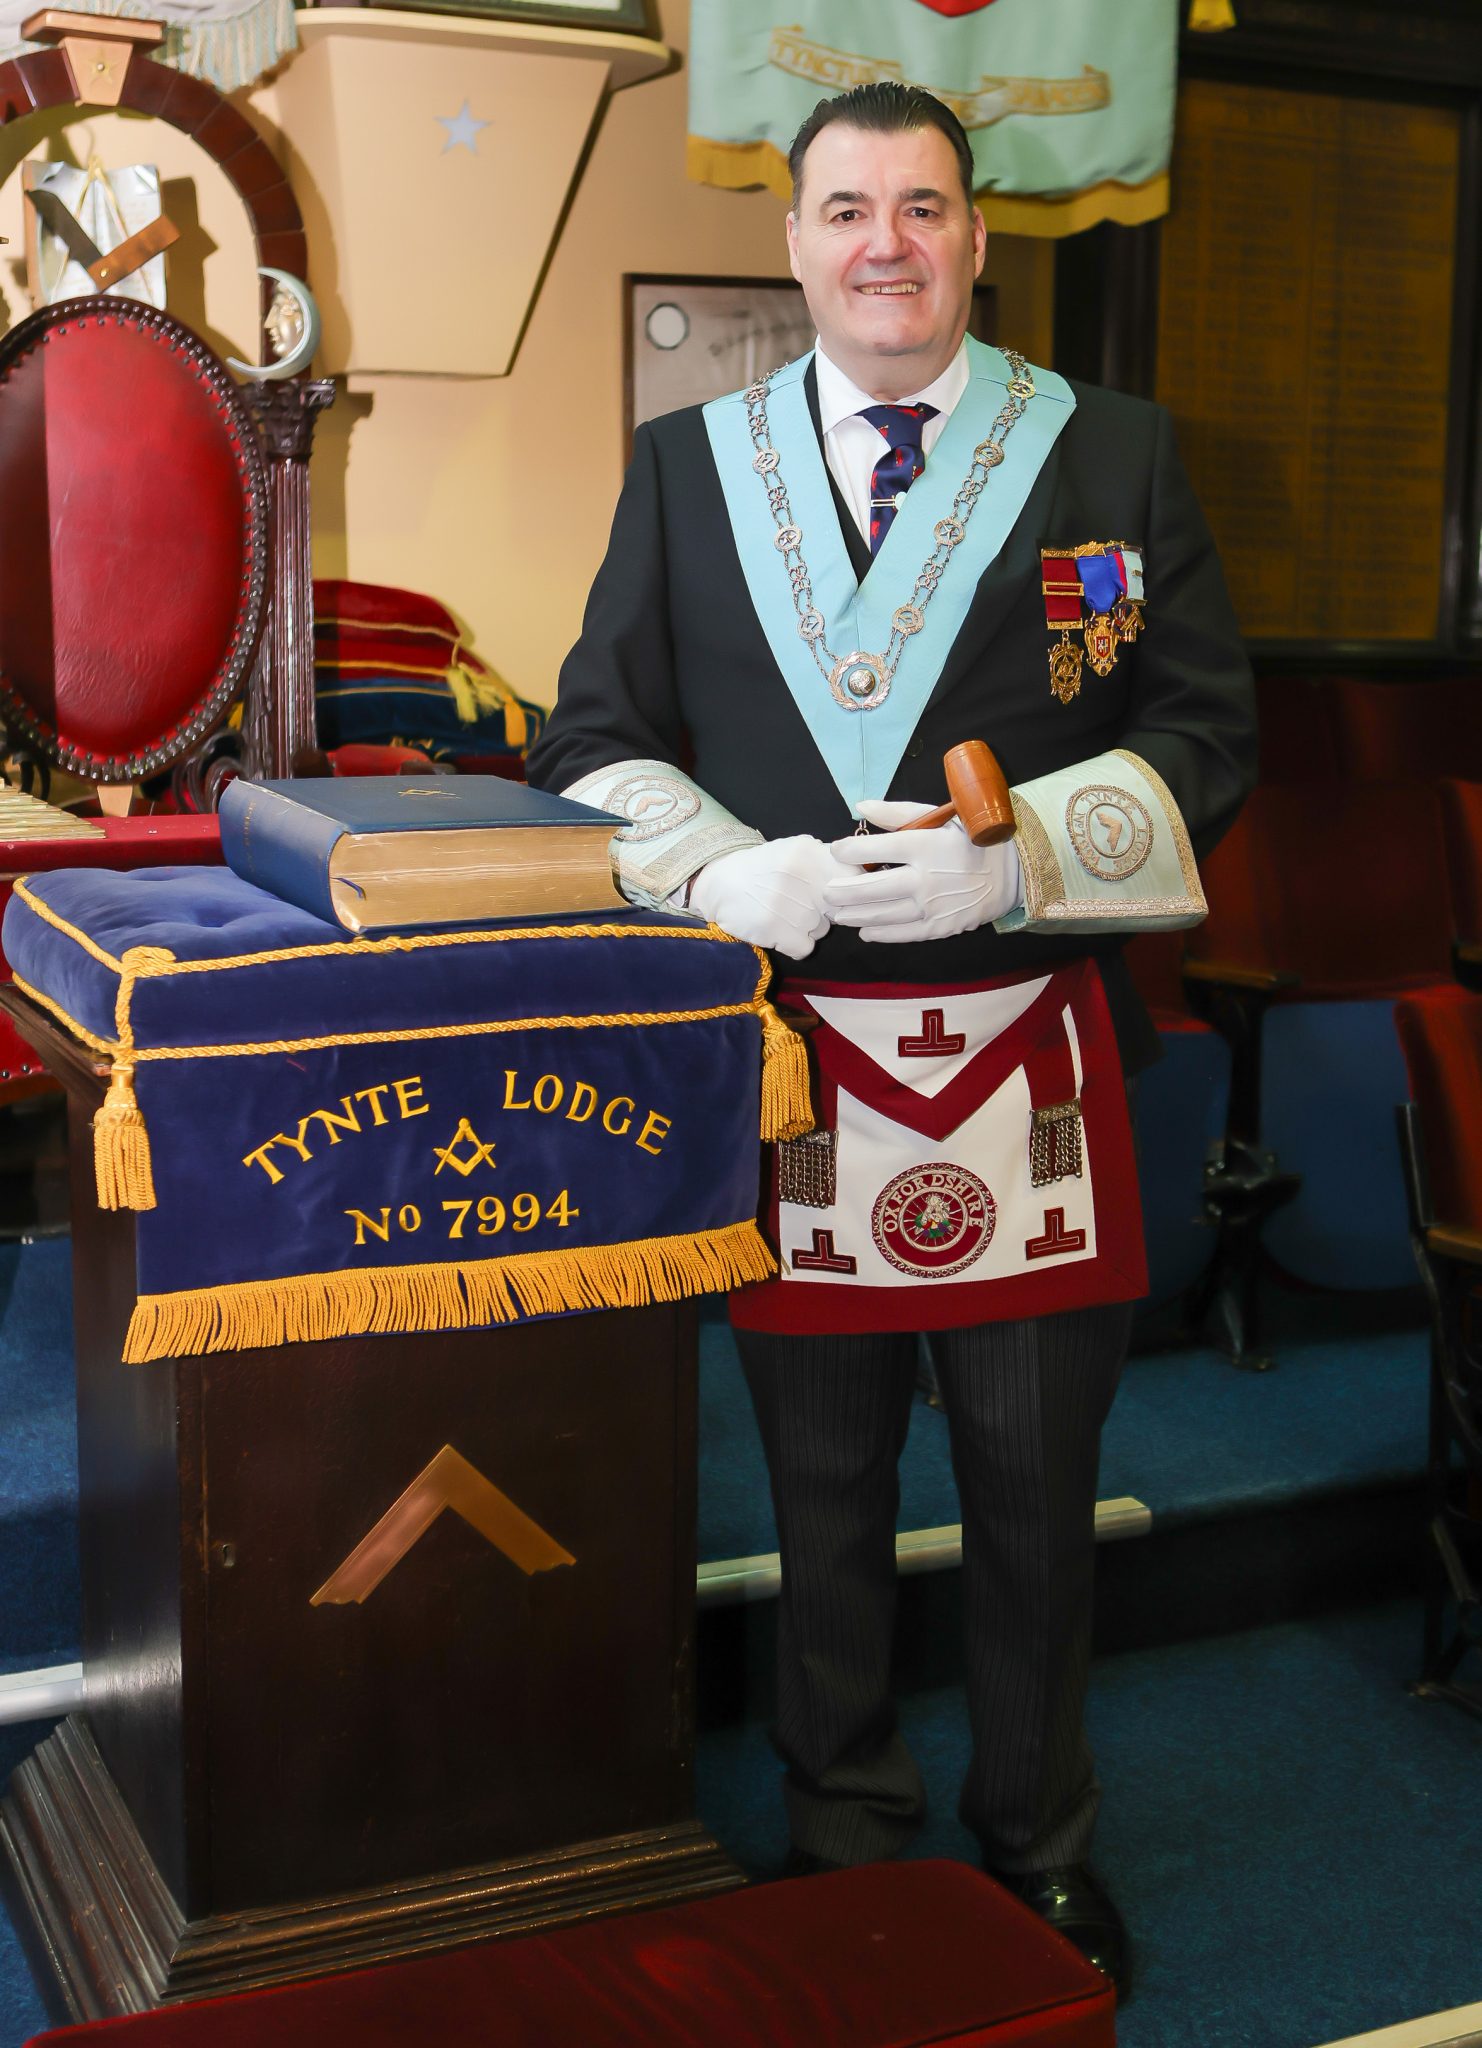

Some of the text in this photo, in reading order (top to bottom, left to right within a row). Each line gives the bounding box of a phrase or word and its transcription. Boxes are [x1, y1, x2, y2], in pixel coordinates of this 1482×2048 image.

[242, 1070, 672, 1185] TYNTE LODGE
[441, 1189, 580, 1238] 7994
[883, 1174, 984, 1233] OXFORDSHIRE
